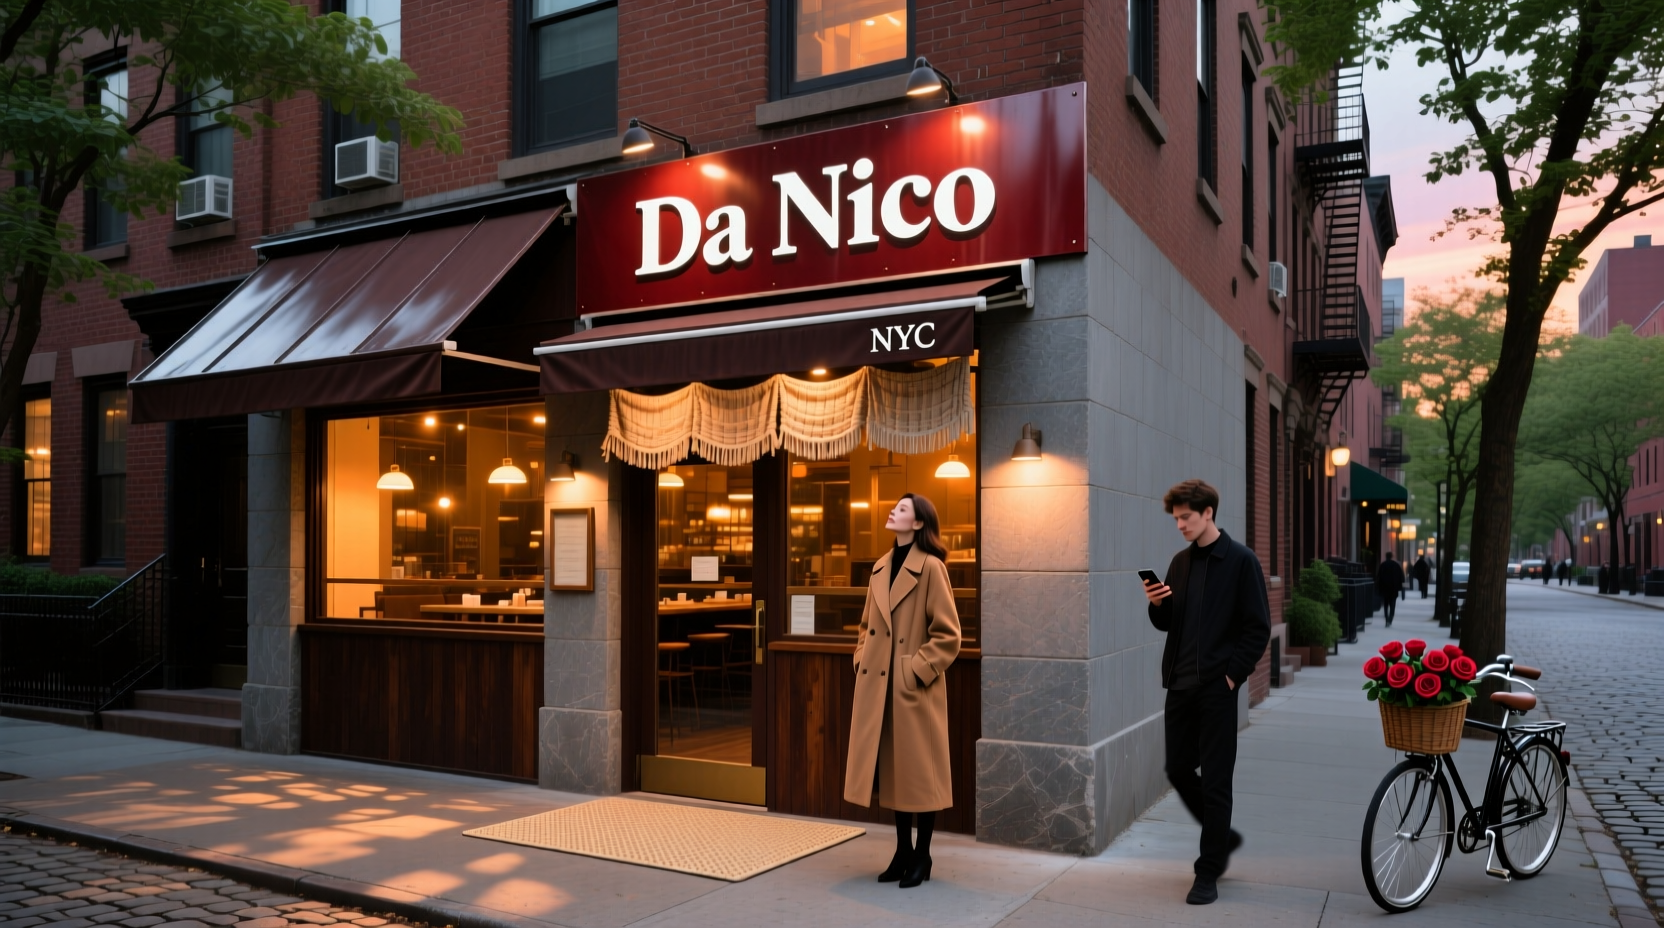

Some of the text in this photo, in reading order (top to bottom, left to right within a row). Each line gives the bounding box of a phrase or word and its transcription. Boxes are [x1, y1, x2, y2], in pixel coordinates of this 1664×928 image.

[634, 157, 997, 277] Da Nico
[869, 322, 936, 353] NYC
